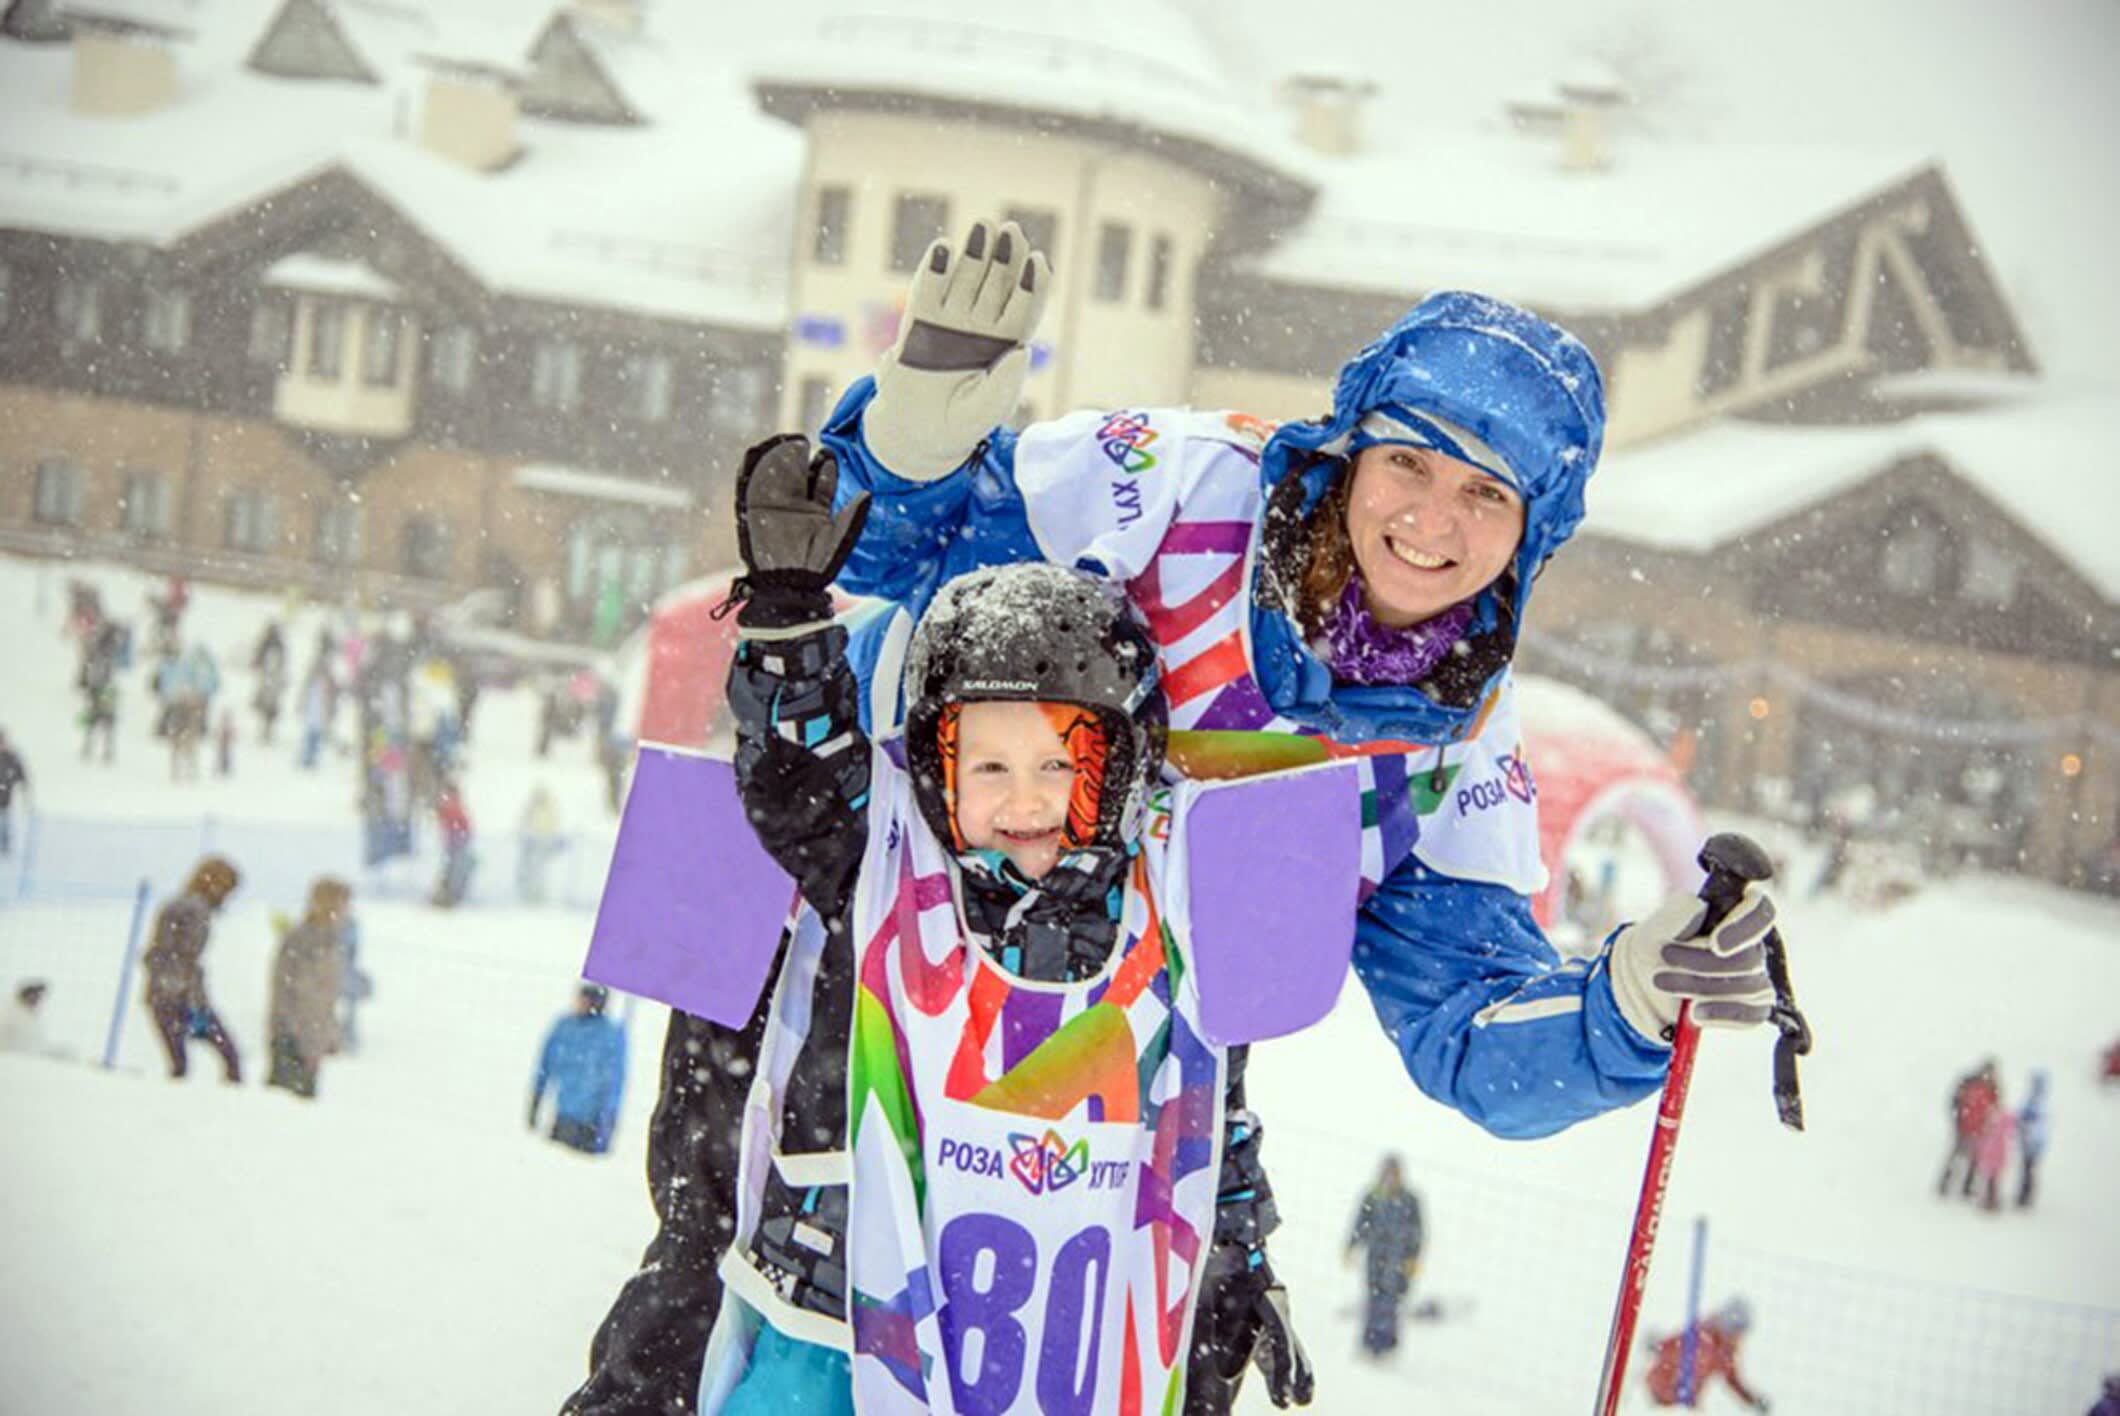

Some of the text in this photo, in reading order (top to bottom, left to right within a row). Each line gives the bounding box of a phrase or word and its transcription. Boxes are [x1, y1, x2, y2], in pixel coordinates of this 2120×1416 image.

[962, 680, 1039, 691] SALOMON
[938, 1138, 1004, 1179] РОЗА
[937, 1212, 1112, 1416] 80
